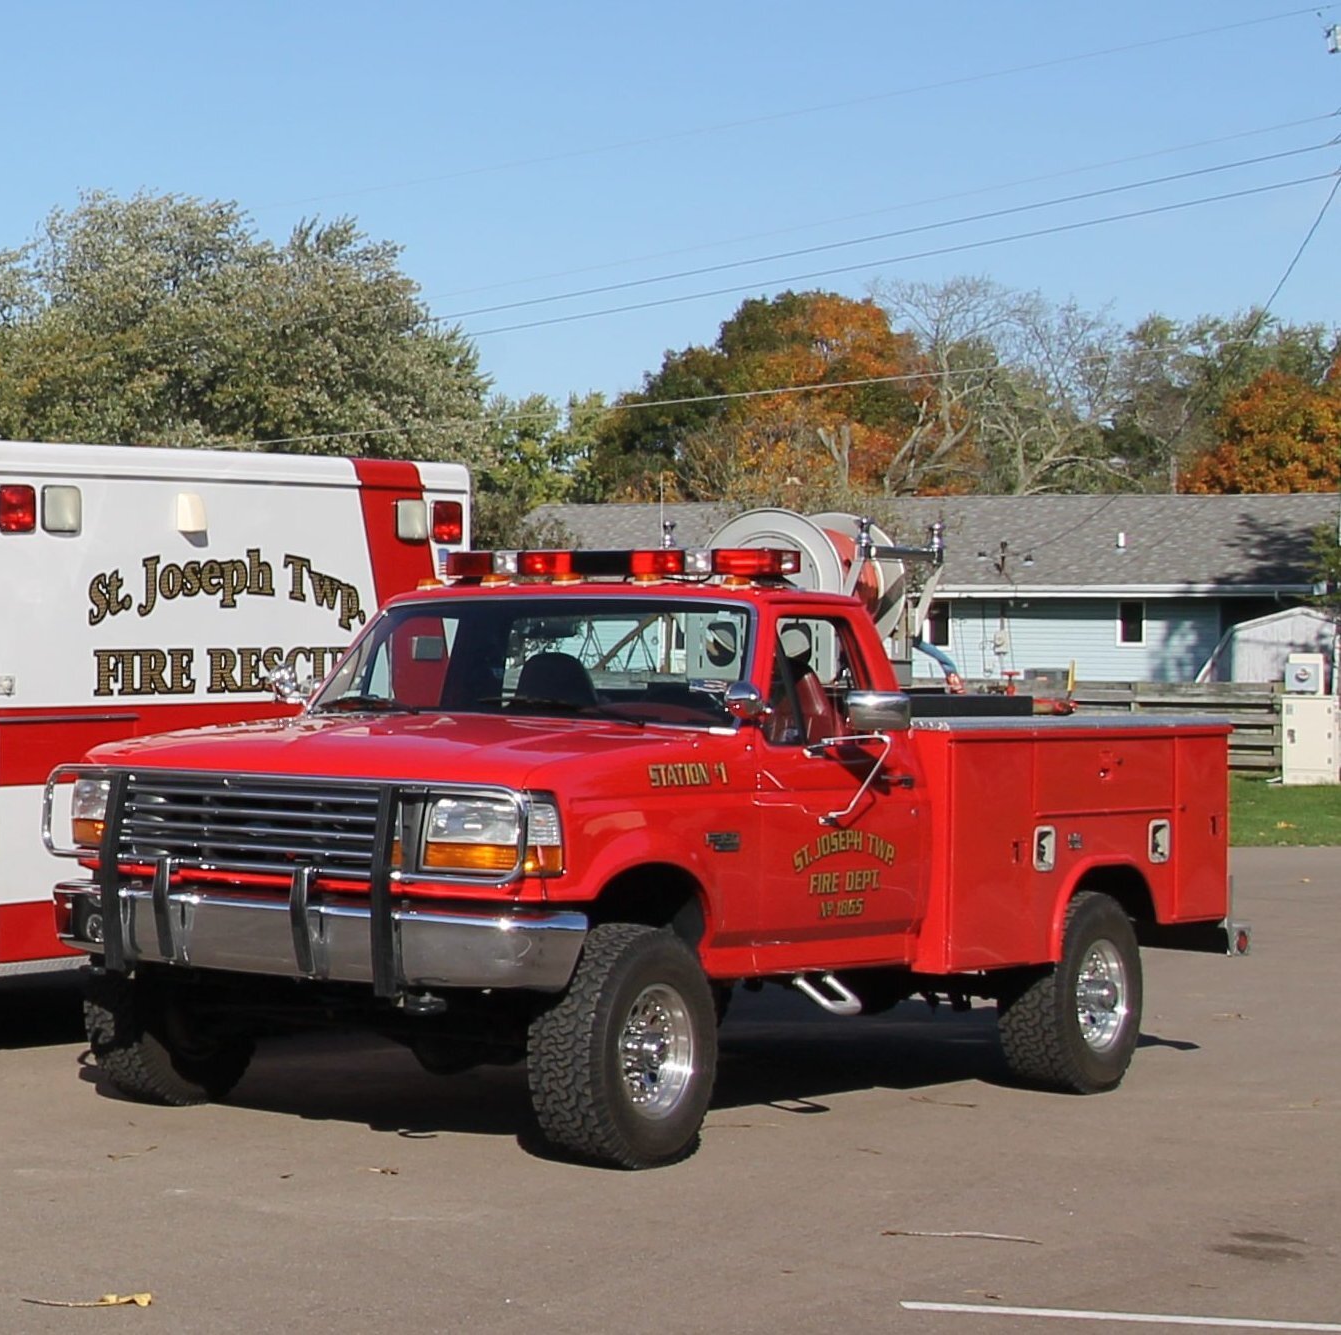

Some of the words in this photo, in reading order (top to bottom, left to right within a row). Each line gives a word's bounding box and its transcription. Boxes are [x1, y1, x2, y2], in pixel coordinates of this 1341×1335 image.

[88, 569, 131, 626] St.
[137, 548, 275, 617] Joseph
[283, 553, 366, 631] Twp.
[93, 648, 196, 696] FIRE
[207, 647, 349, 693] RESCU
[648, 763, 710, 787] STATION
[793, 844, 813, 873] ST.
[815, 830, 863, 860] JOSEPH
[809, 872, 839, 894] FIRE
